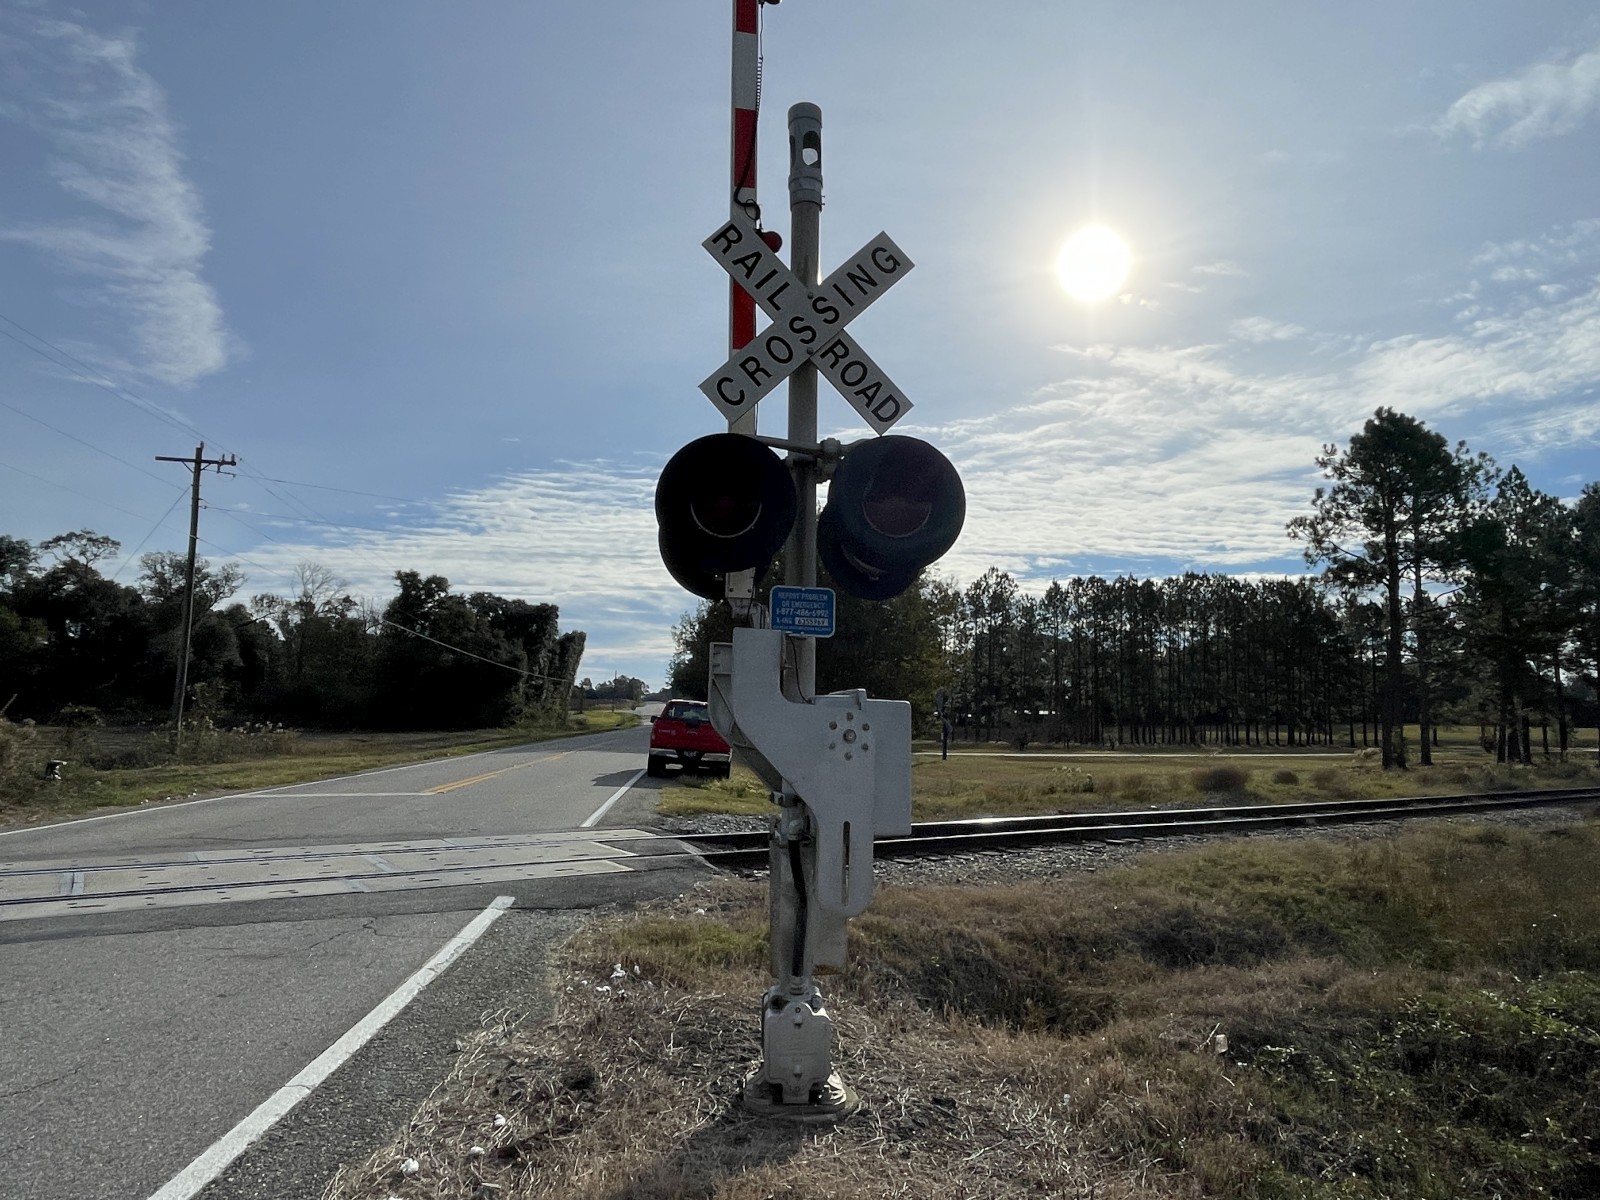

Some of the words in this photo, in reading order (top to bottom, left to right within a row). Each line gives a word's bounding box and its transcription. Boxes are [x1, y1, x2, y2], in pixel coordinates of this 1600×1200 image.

[711, 223, 790, 312] RAIL
[820, 338, 901, 423] ROAD
[716, 246, 901, 407] CROSSING
[778, 592, 799, 600] REPORT
[801, 593, 828, 601] PROBLEM
[791, 601, 825, 609] EMERGENCY
